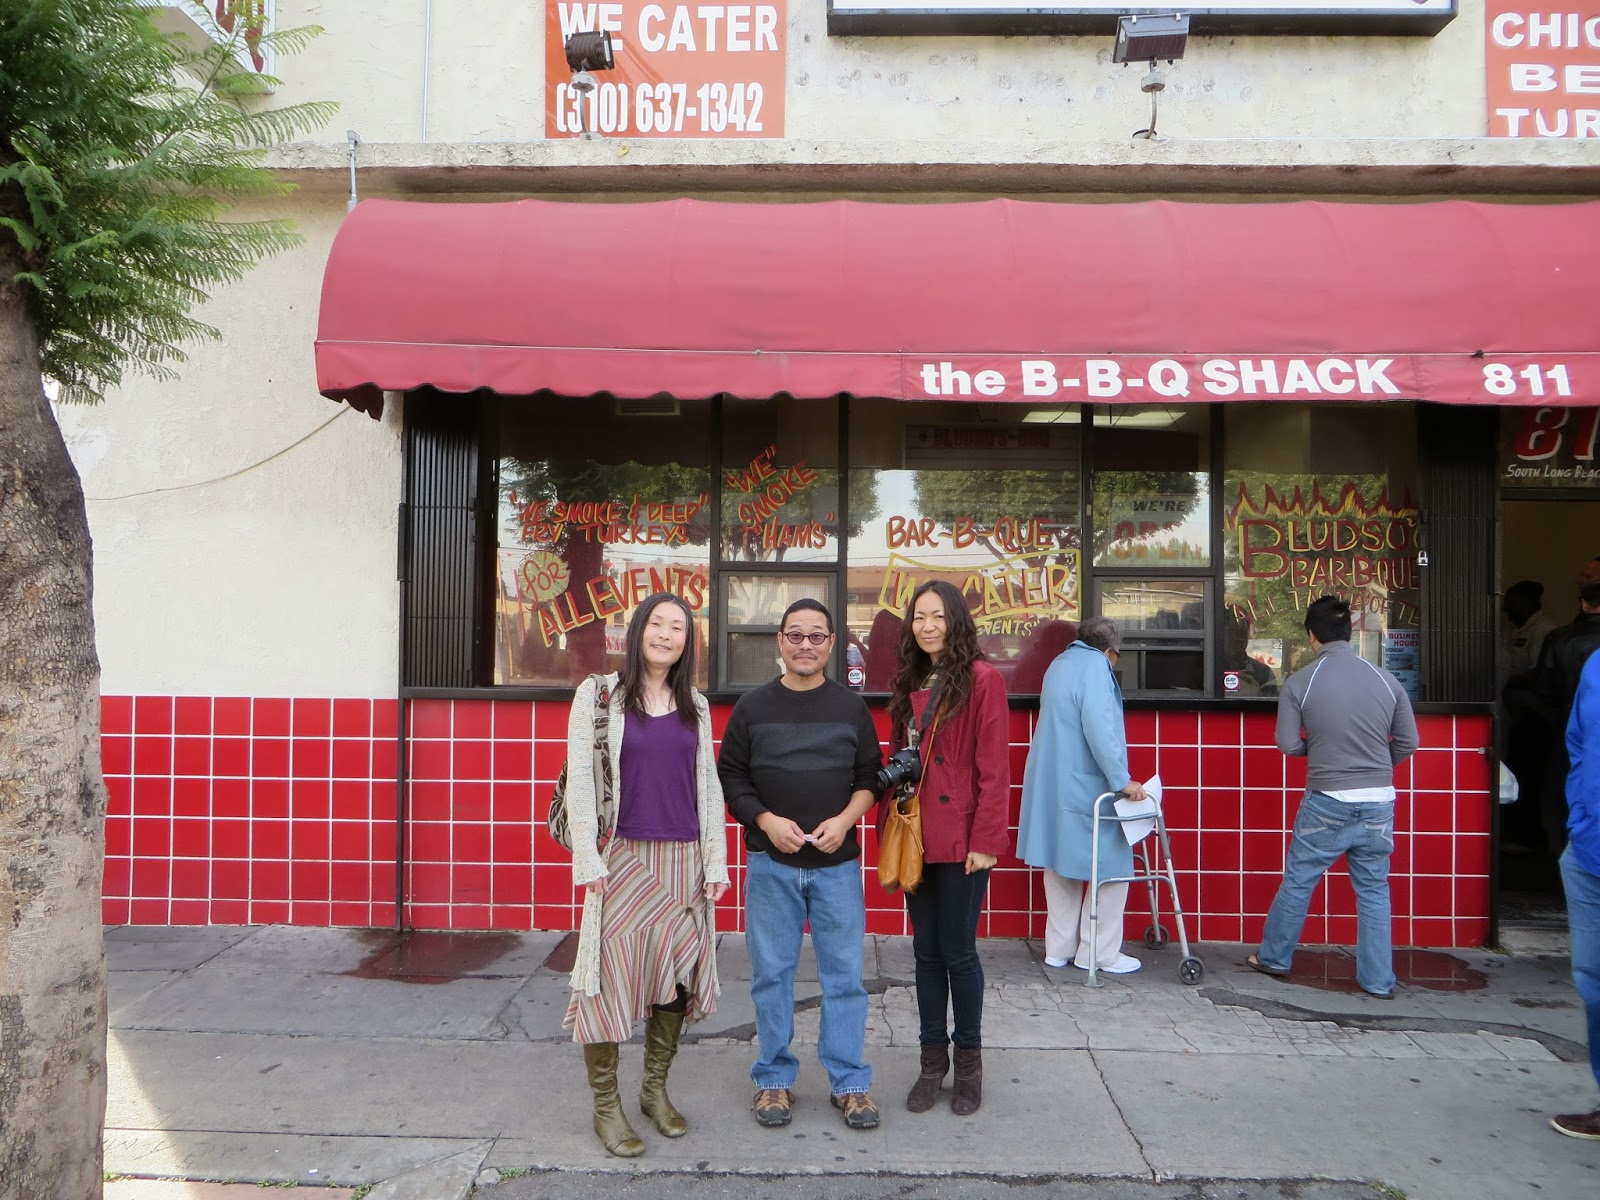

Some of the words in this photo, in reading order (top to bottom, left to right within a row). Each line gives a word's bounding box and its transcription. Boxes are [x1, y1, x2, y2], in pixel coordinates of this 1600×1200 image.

[558, 2, 623, 51] WE
[638, 5, 778, 52] CATER
[1510, 63, 1600, 93] BE
[556, 83, 628, 132] (310)
[635, 82, 763, 132] 637-1342
[920, 362, 1006, 396] the
[1021, 359, 1190, 397] B-B-Q
[1202, 359, 1401, 395] SHACK
[1483, 363, 1571, 396] 811
[1505, 463, 1540, 478] SOUTH
[1544, 464, 1572, 478] LONG
[553, 500, 622, 524] SMOKE
[628, 494, 642, 525] &
[738, 460, 819, 533] SMOKE
[1133, 500, 1187, 512] WE'RE
[521, 522, 565, 544] FRY
[577, 523, 690, 546] TURKEYS
[886, 515, 1057, 553] BAR-B-QUE
[537, 590, 595, 648] ALL
[586, 566, 708, 619] EVENTS
[961, 564, 1078, 619] CATER
